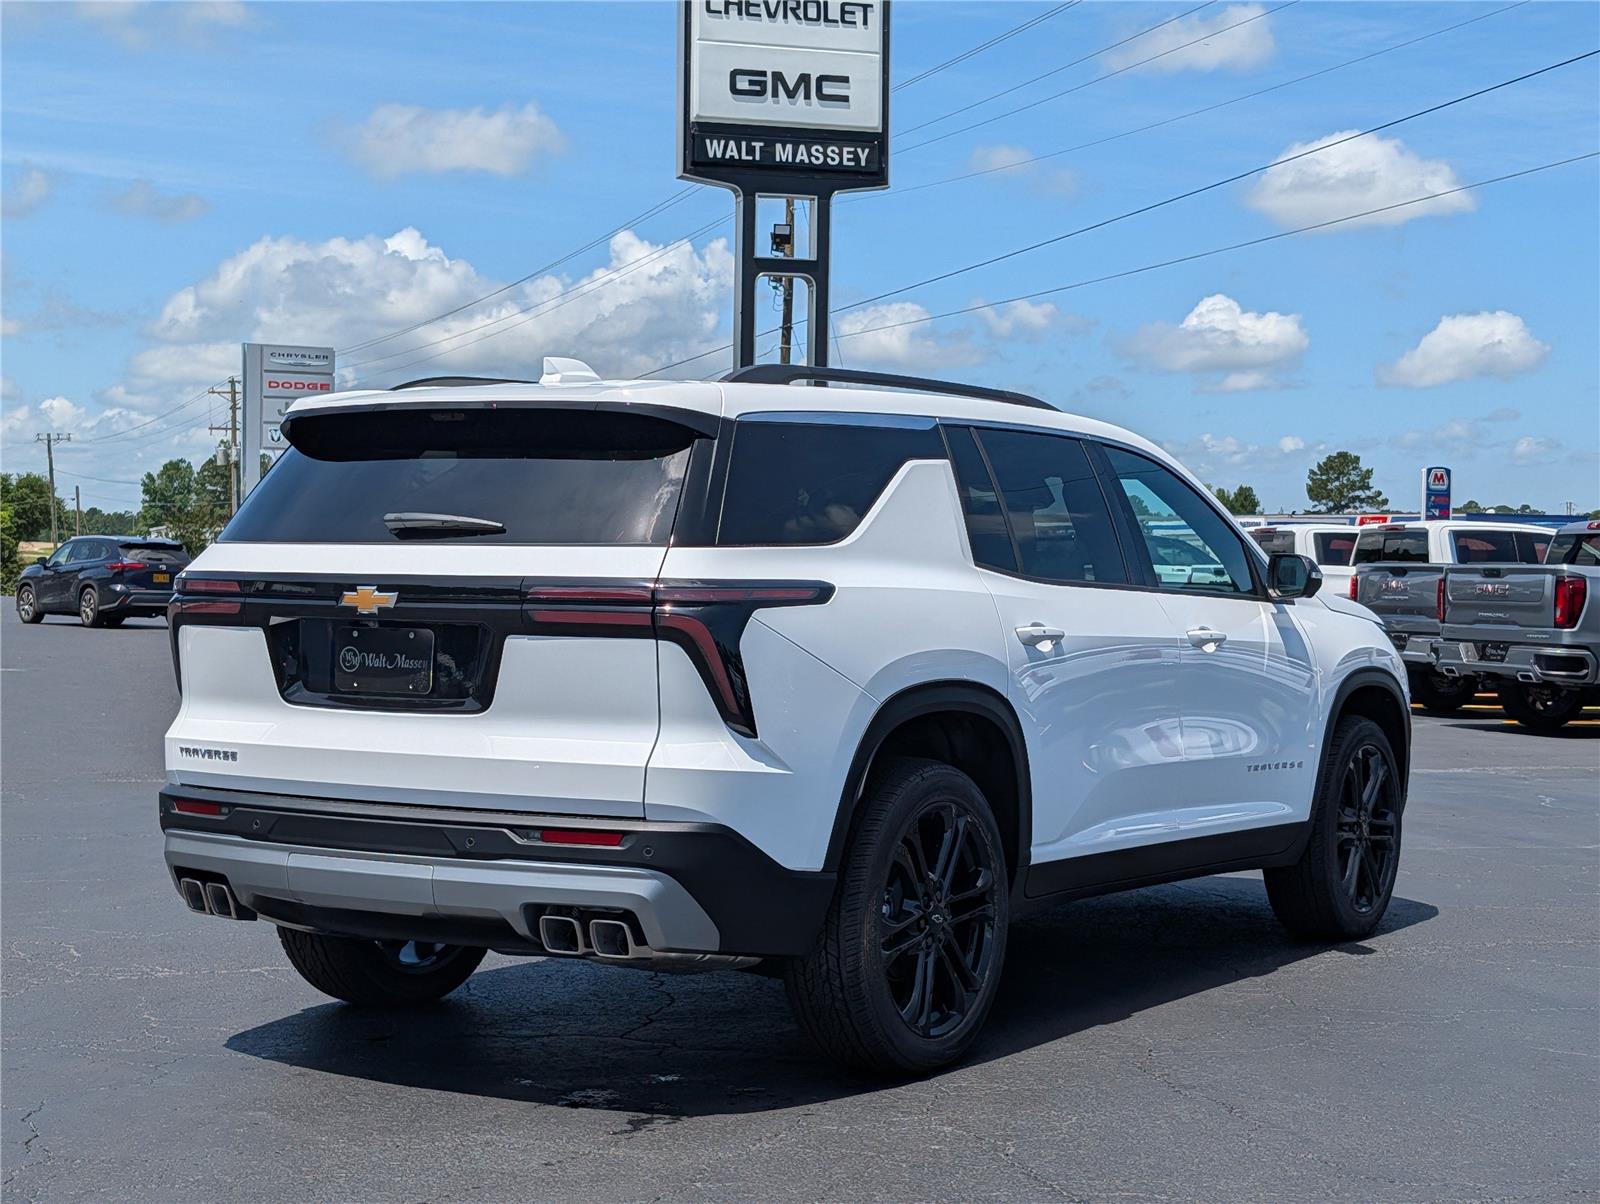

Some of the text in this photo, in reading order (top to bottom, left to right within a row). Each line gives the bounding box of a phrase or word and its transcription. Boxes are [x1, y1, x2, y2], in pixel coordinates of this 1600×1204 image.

[705, 0, 873, 26] CHEVROLET
[730, 68, 850, 102] GMC
[705, 139, 870, 167] WALT MASSEY
[270, 352, 329, 360] CHRYSLER
[268, 380, 331, 391] DODGE
[360, 652, 386, 668] Walt
[386, 653, 428, 671] Massey
[179, 746, 238, 762] TRAVERSE
[1246, 761, 1304, 772] TRAVERSE
